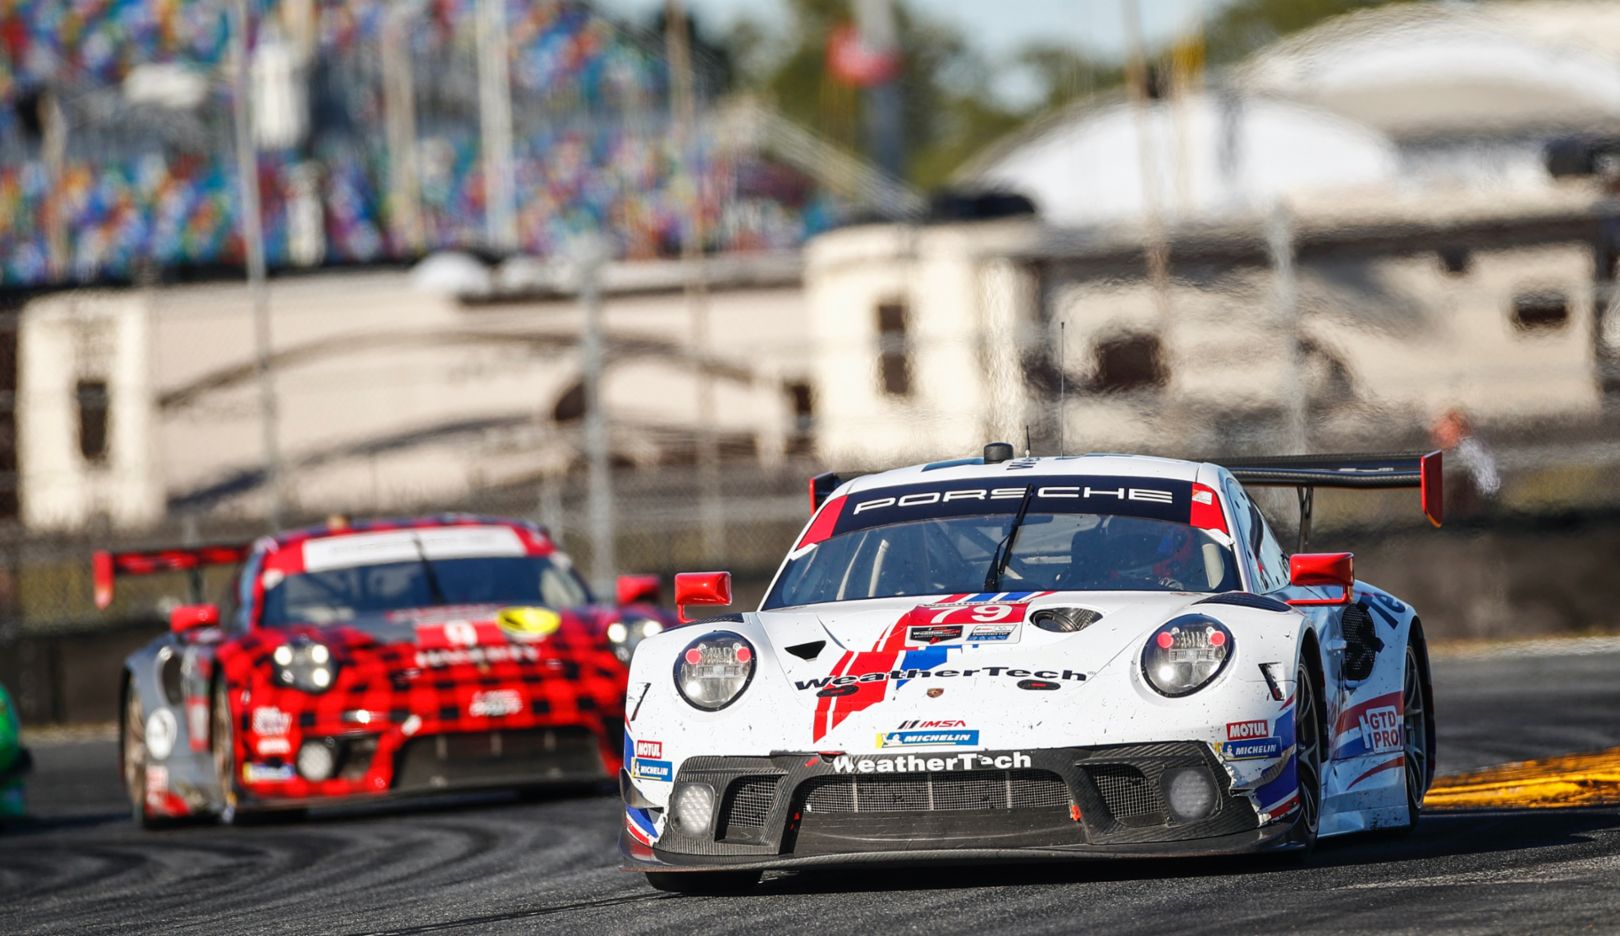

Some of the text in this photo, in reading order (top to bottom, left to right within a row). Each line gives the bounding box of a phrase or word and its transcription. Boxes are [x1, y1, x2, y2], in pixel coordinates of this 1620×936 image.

[853, 486, 1173, 515] PORSCHE
[929, 604, 1013, 624] 79
[795, 666, 1087, 691] WeatherTech
[919, 719, 966, 728] IMSA
[1369, 710, 1396, 730] GTD
[903, 733, 970, 743] MICHELIN
[1229, 722, 1268, 738] MOTUL
[1373, 729, 1399, 749] PRO
[637, 742, 661, 757] MOTUL
[1235, 743, 1277, 756] MICHELIN
[640, 765, 669, 776] MICHELIN
